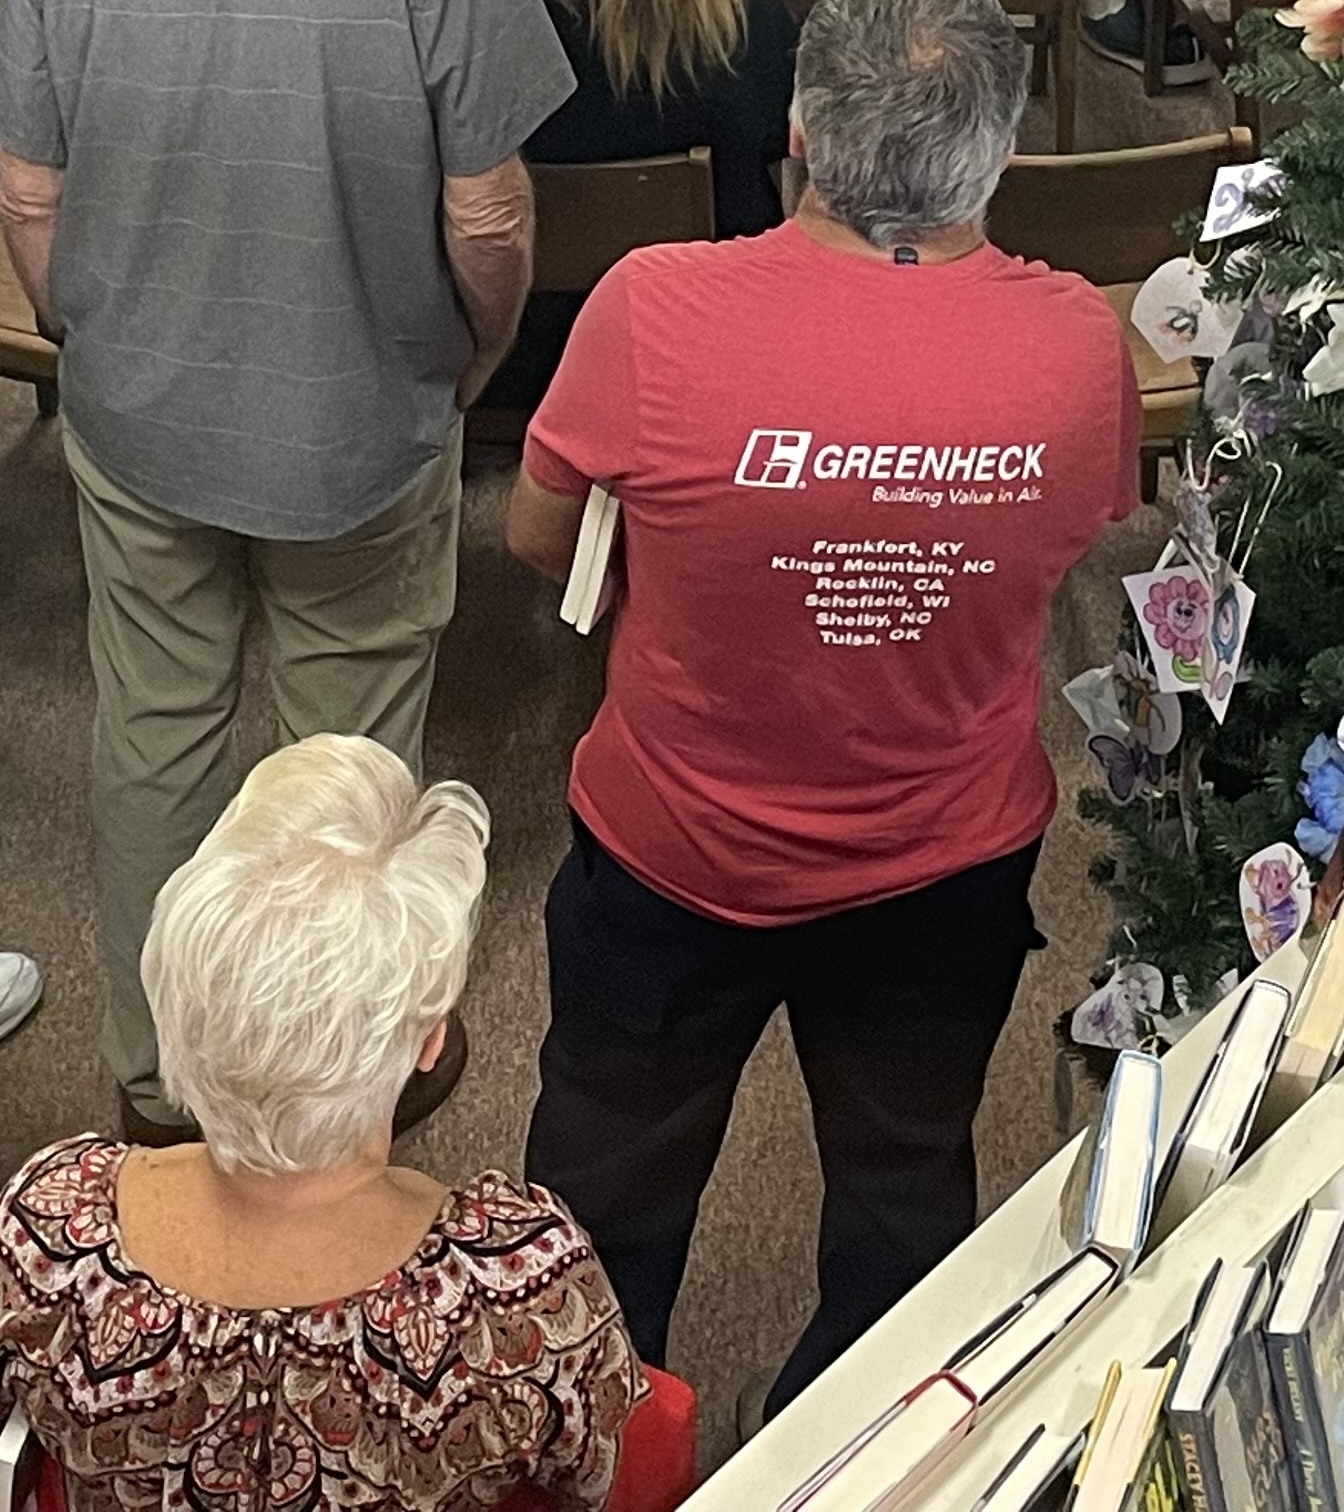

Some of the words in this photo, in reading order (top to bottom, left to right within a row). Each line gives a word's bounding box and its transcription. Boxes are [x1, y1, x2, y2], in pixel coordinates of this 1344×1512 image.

[812, 443, 1047, 482] GREENHECK
[872, 486, 943, 508] Building
[949, 488, 994, 504] Value
[998, 488, 1013, 502] in
[812, 540, 924, 557] Frankfort,
[931, 542, 965, 556] KY
[771, 556, 836, 574] Kings
[843, 558, 955, 576] Mountain,
[962, 560, 996, 574] NC
[815, 576, 905, 593] Rocklin,
[913, 578, 945, 591] CA
[804, 593, 914, 609] Schofield,
[922, 594, 951, 608] WI
[815, 611, 892, 628] Shelby,
[899, 611, 932, 625] NC
[819, 630, 882, 646] Tulsa,
[889, 628, 923, 642] OK
[1179, 1432, 1206, 1495] STACEY
